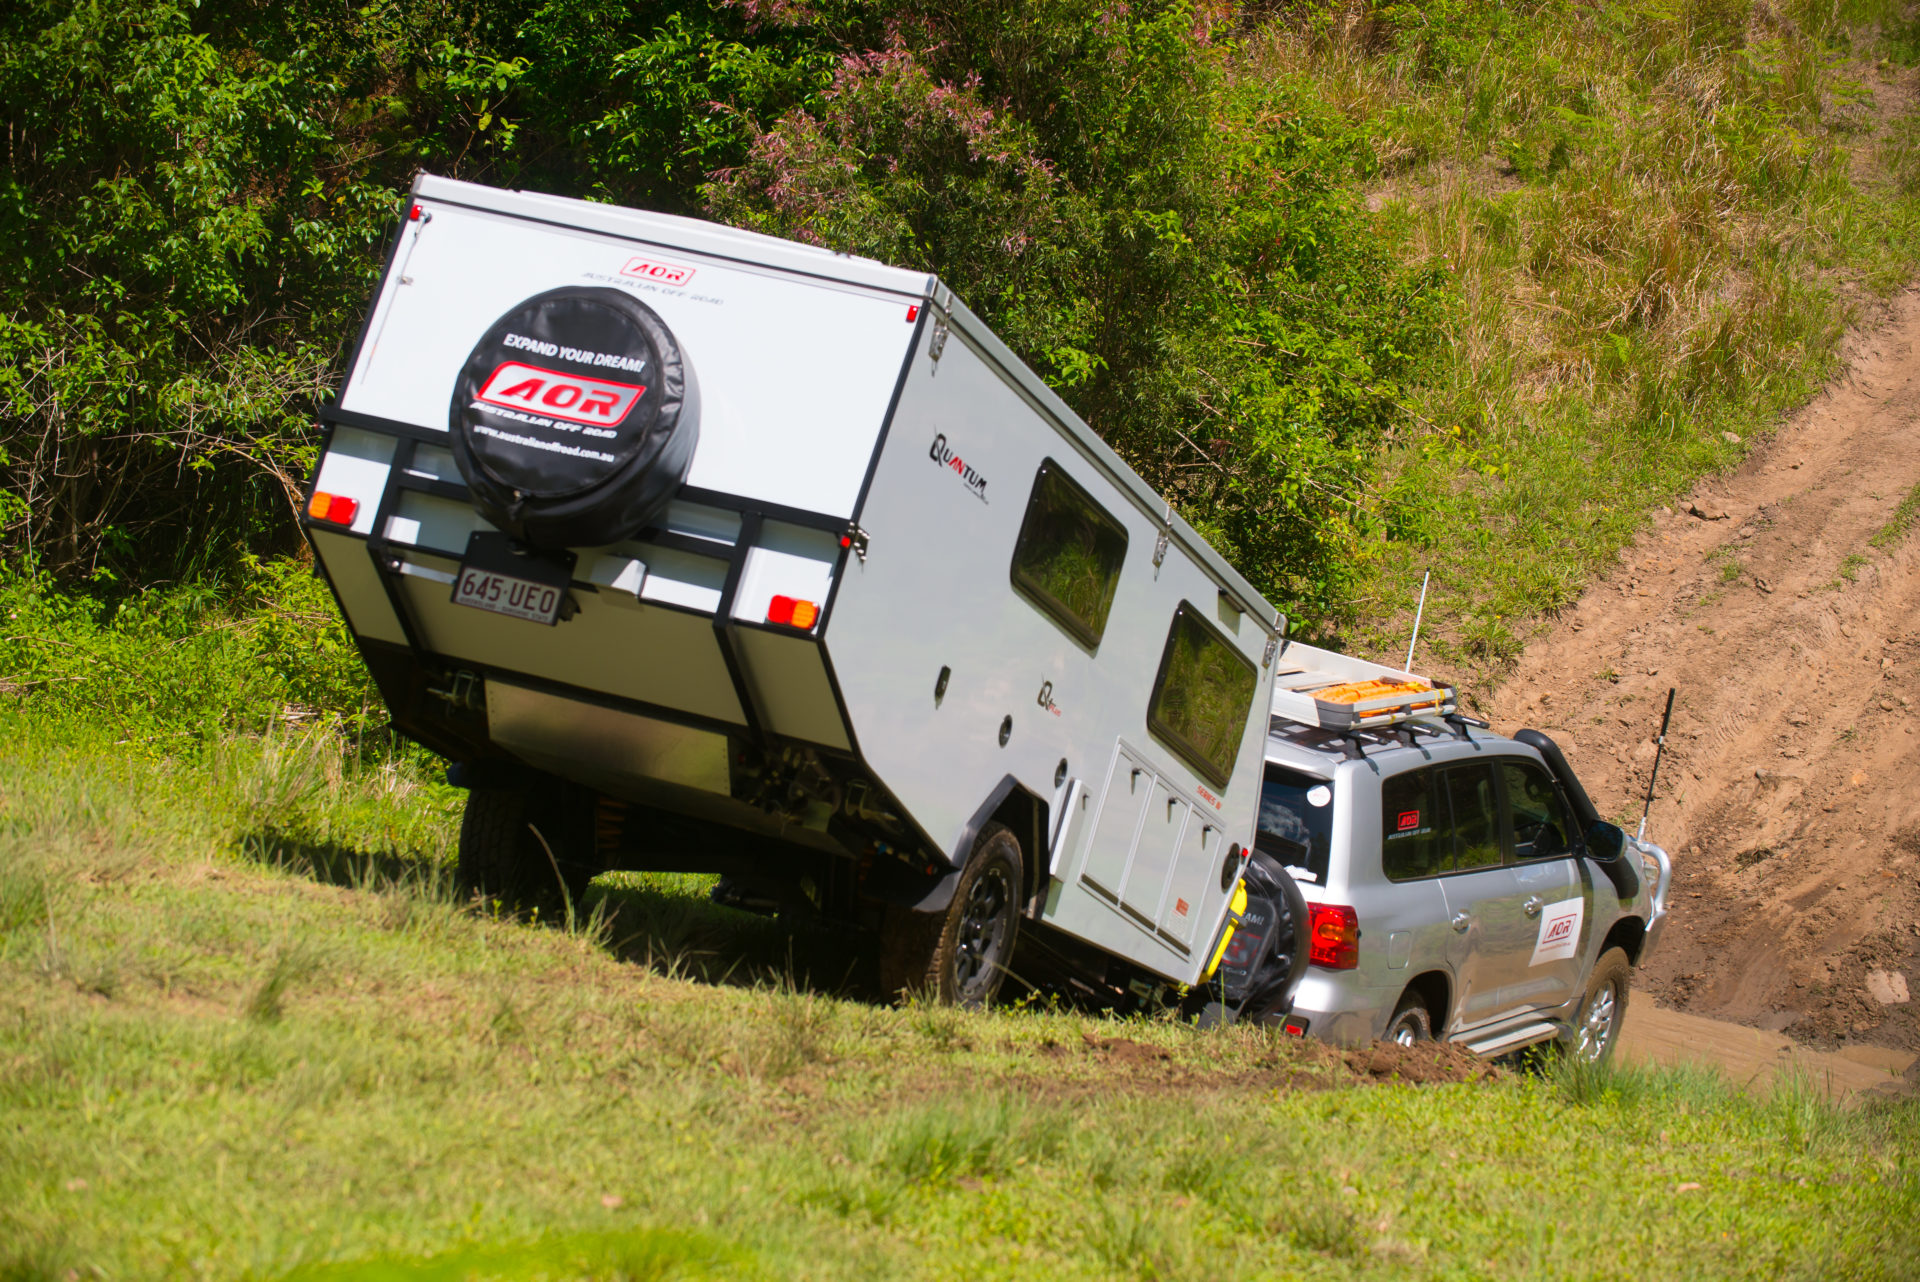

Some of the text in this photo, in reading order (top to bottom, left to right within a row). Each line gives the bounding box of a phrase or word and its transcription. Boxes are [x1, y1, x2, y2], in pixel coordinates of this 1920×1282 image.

[582, 272, 657, 292] AUSTRALIAN
[661, 286, 687, 297] OFF
[632, 264, 685, 281] AOR
[503, 333, 646, 373] EXPAND YOUR DREAM!
[498, 378, 622, 417] AOR
[469, 402, 618, 439] AUSTRALIAN OFF ROAD
[473, 425, 615, 463] www.australianoffroad.com.au
[1547, 919, 1572, 939] AOR
